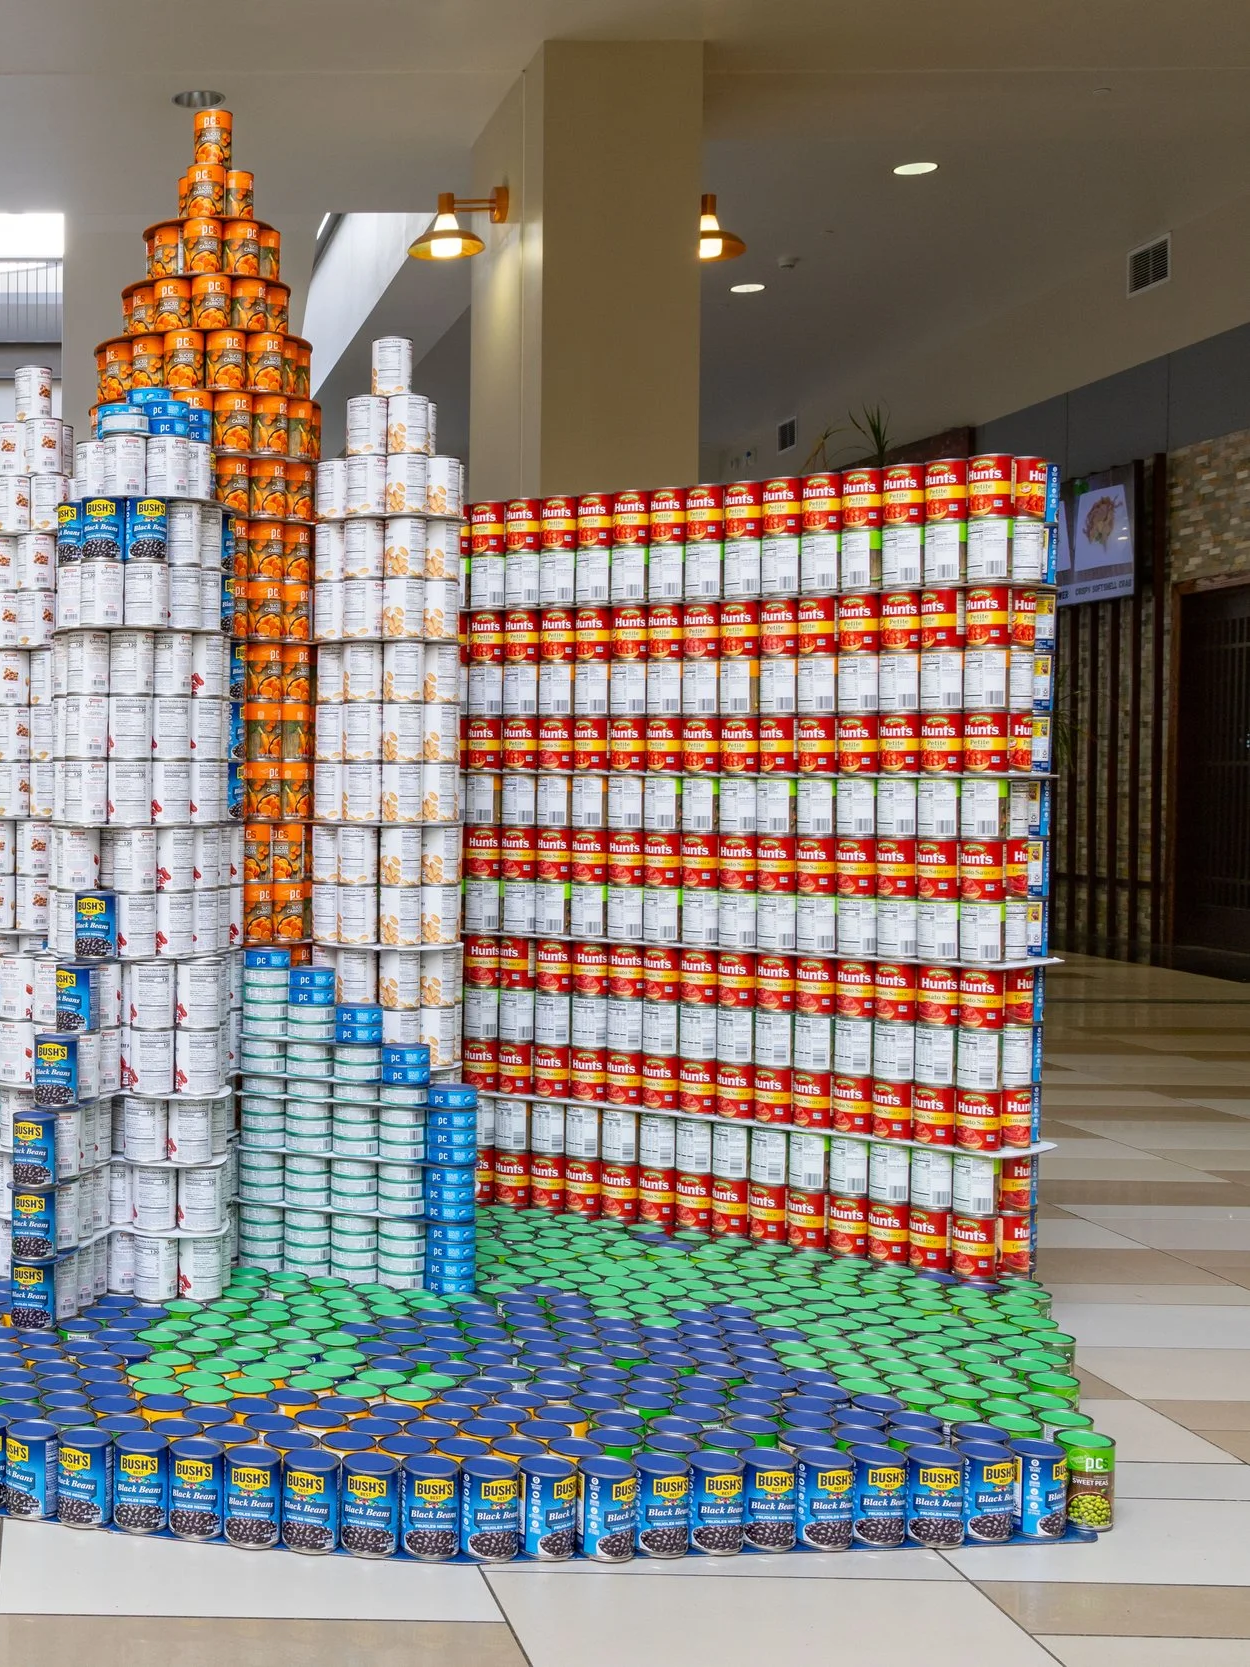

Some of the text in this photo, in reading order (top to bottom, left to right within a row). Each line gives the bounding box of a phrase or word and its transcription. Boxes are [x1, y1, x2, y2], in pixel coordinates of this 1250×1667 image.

[88, 504, 114, 513] BUSH'S
[84, 524, 118, 532] Black Beans
[79, 902, 104, 912] BUSH'S
[38, 1047, 66, 1057] BUSH'S
[16, 1198, 44, 1208] BUSH'S
[28, 1220, 48, 1228] Beans
[122, 1459, 157, 1472] BUSH'S
[177, 1464, 211, 1478] BUSH'S
[234, 1472, 268, 1486] BUSH'S
[758, 1474, 793, 1487] BUSH'S
[922, 1472, 958, 1484] BUSH'S
[1072, 1478, 1094, 1486] SWEET
[118, 1483, 162, 1494] Black Beans
[350, 1478, 384, 1494] BUSH'S
[418, 1482, 452, 1494] BUSH'S
[173, 1489, 216, 1500] Black Beans
[229, 1497, 273, 1508] Black Beans
[752, 1502, 775, 1510] Black
[916, 1498, 940, 1506] Black
[345, 1504, 390, 1518] Black Beans
[412, 1510, 456, 1518] Black Beans
